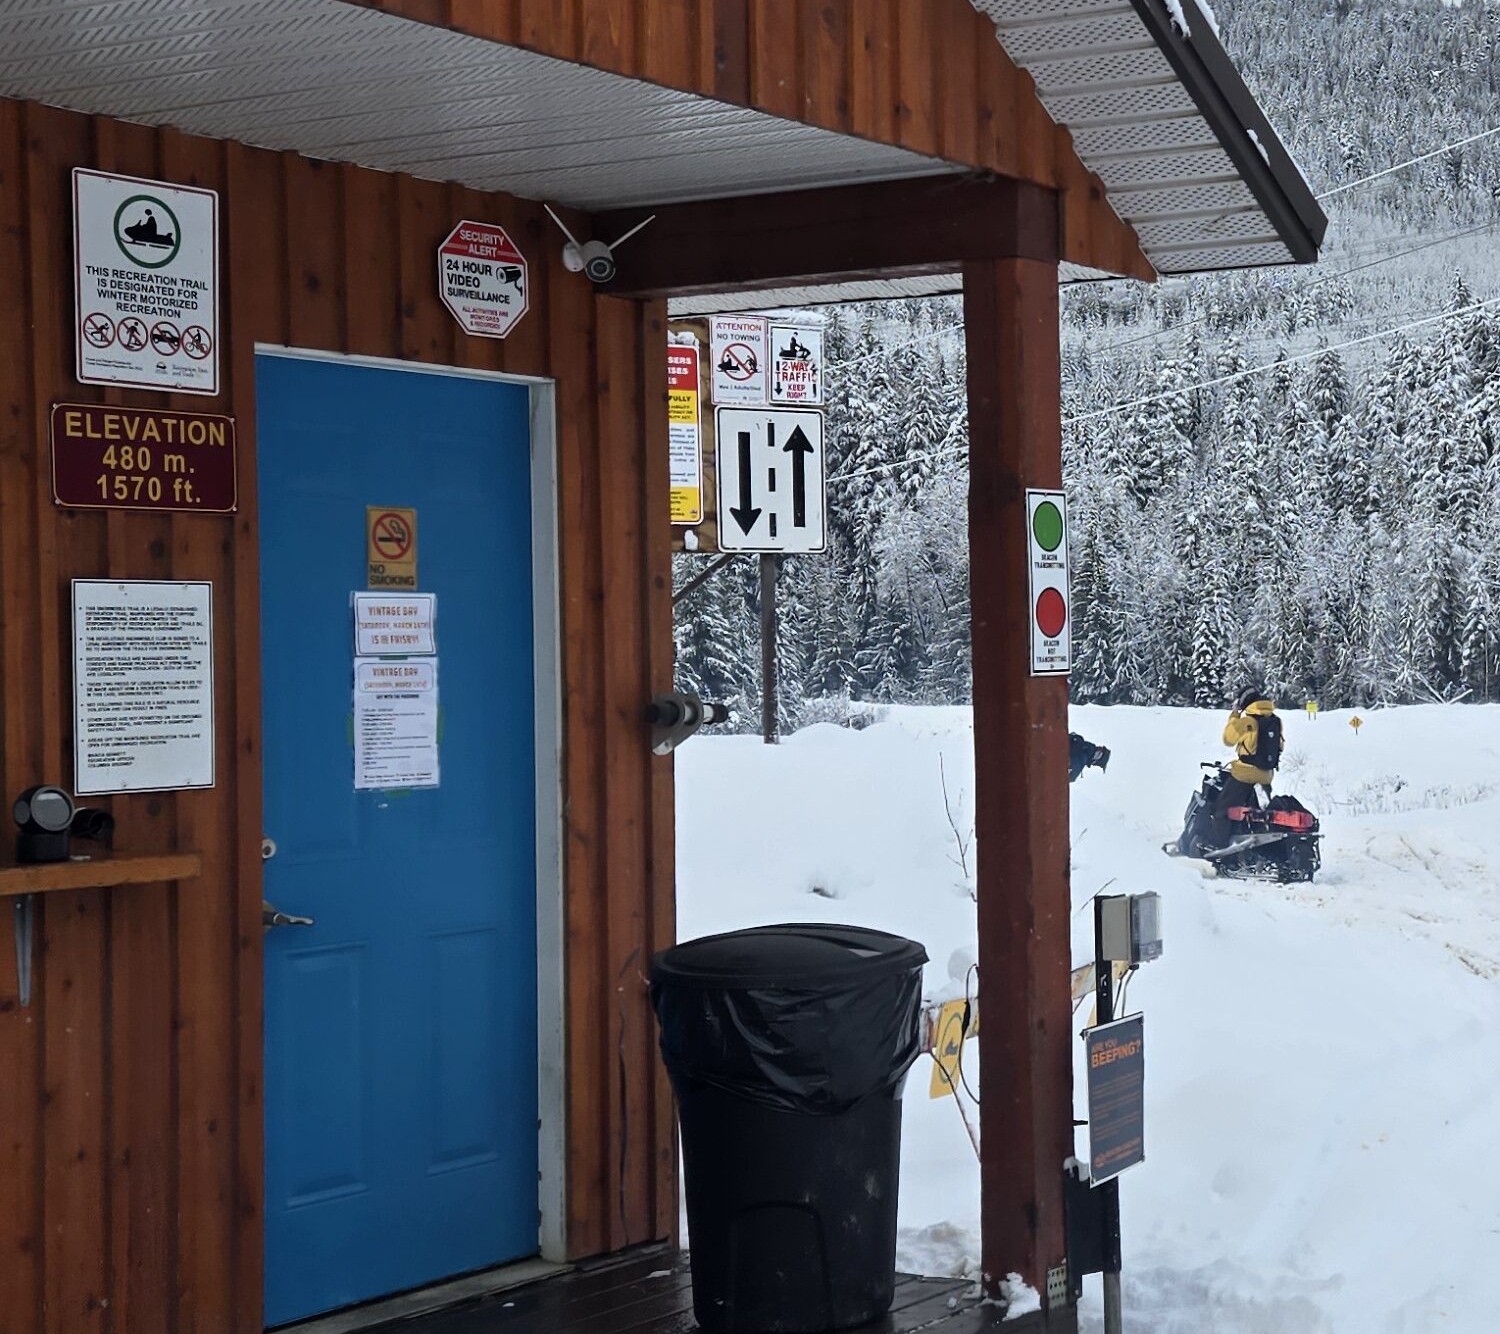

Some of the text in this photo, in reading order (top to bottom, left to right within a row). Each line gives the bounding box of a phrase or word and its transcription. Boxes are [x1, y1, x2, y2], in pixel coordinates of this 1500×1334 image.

[460, 229, 504, 246] SECURITY
[468, 244, 497, 257] ALERT
[446, 259, 492, 276] 24 HOUR
[86, 266, 208, 290] THIS RECREATION TRAIL
[447, 273, 480, 288] VIDEO
[97, 278, 198, 299] IS DESIGNATED FOR
[447, 287, 510, 304] SURVEILLANCE
[97, 289, 198, 310] WINTER MOTORIZED
[116, 302, 181, 318] RECREATION
[716, 323, 762, 331] ATTENTION
[782, 362, 809, 371] 2-WAY
[65, 411, 225, 446] ELEVATION
[102, 444, 195, 473] 480 m.
[97, 474, 200, 503] 1570 ft.
[369, 564, 385, 574] NO
[369, 576, 415, 586] SMOKING
[1091, 1039, 1141, 1068] BEEPING?
